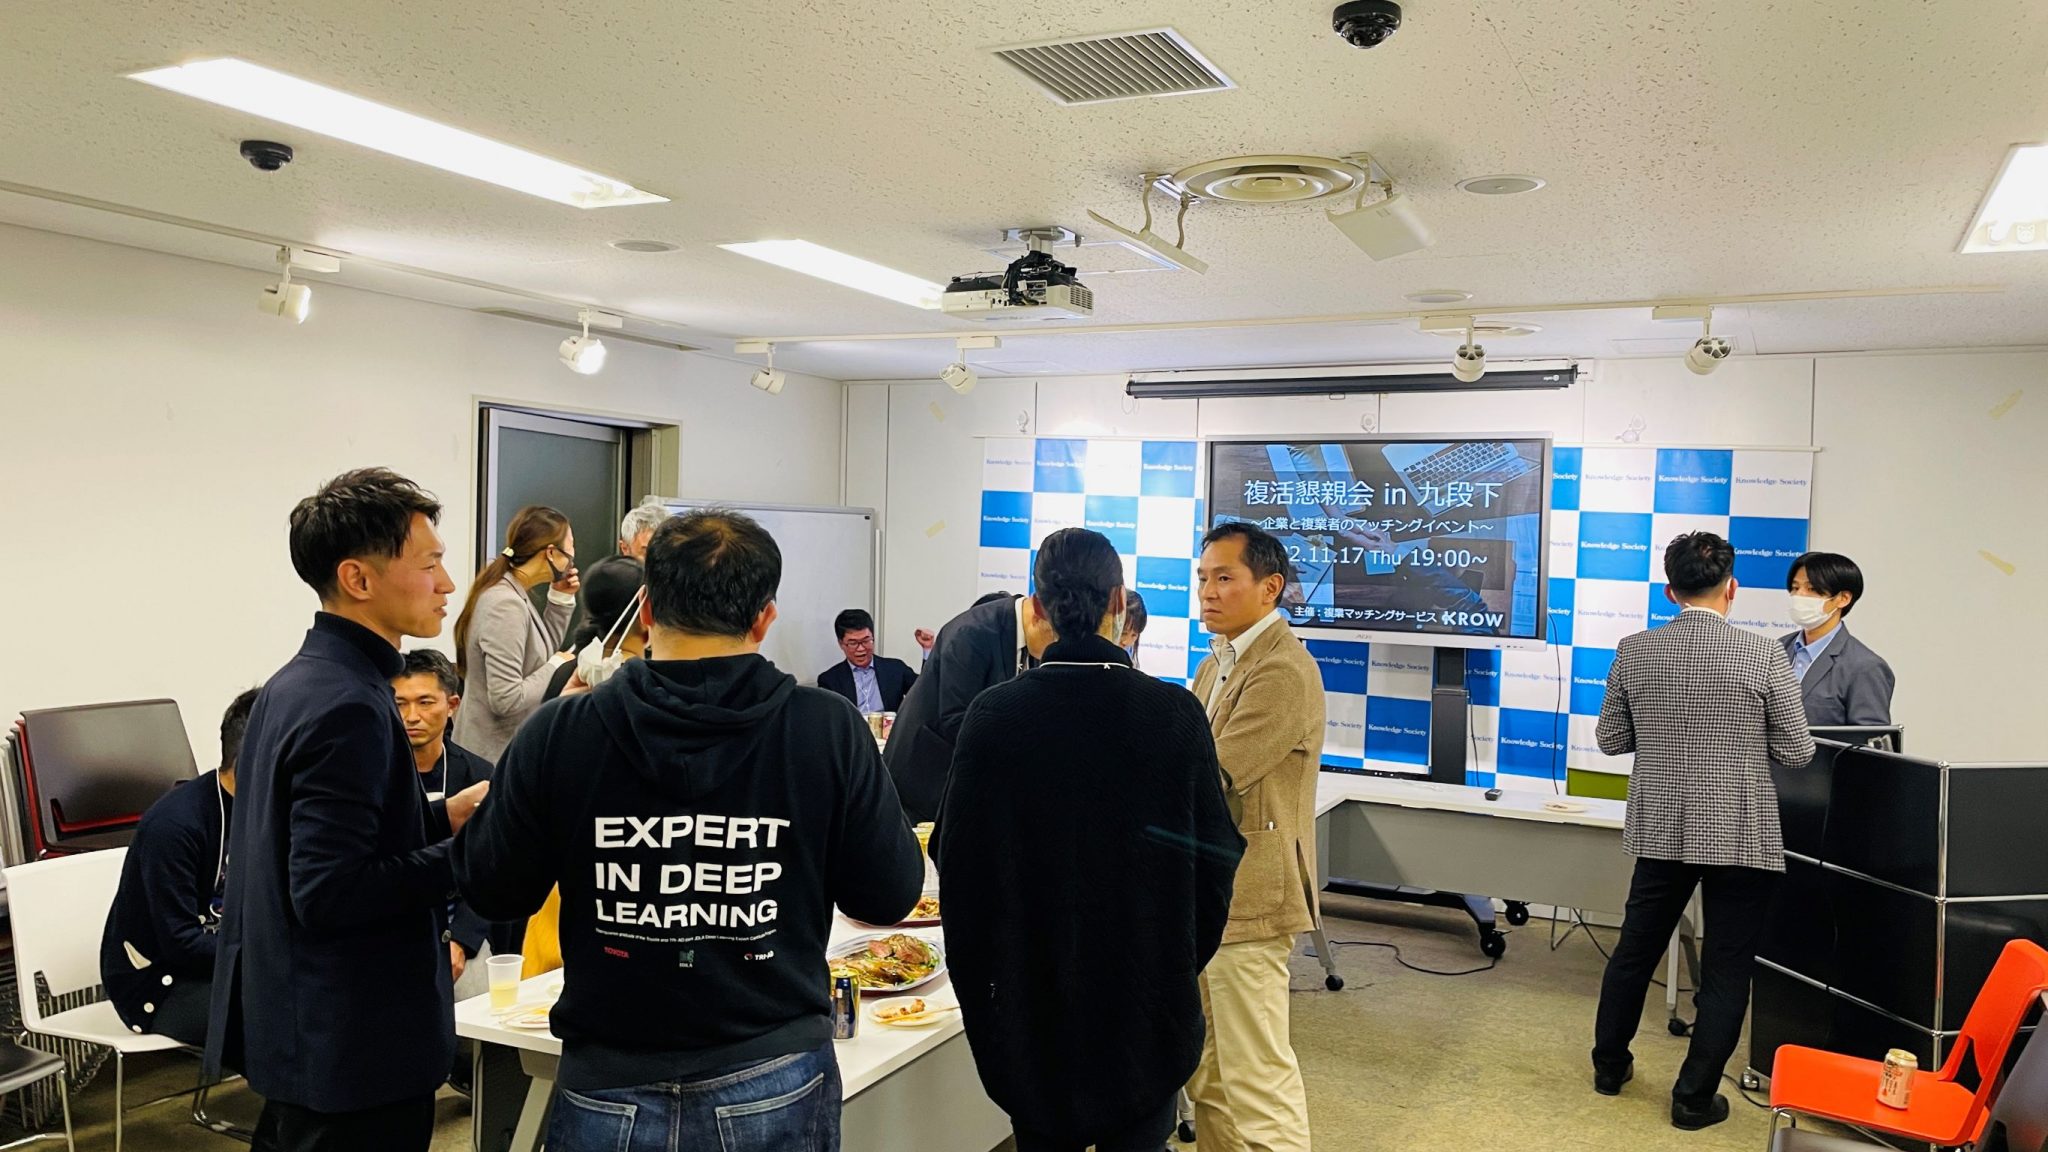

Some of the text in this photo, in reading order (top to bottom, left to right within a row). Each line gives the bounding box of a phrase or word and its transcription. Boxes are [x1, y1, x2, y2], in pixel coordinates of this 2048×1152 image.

[1143, 463, 1172, 471] Knowledge
[1174, 464, 1193, 472] Society
[1553, 472, 1578, 481] Society
[1585, 473, 1650, 483] Knowledge Society
[1659, 474, 1728, 485] Knowledge Society
[1735, 476, 1807, 487] Knowledge Society
[1244, 480, 1503, 508] 複活懇親会 in 九段下
[983, 514, 1030, 524] Knowledge Society
[1086, 519, 1136, 529] Knowledge Society
[1581, 540, 1620, 550] Knowledge
[1621, 542, 1648, 551] Society
[1284, 545, 1364, 564] 2.11.17
[1370, 549, 1402, 565] Thu
[1734, 546, 1773, 557] Knowledge
[1137, 581, 1188, 591] Knowledge Society
[1547, 606, 1571, 617] Society
[1577, 610, 1644, 620] Knowledge Society
[1442, 611, 1504, 628] KROW
[1651, 614, 1677, 623] Knowl
[1728, 618, 1797, 629] Knowledge Society
[1315, 657, 1365, 667] nowledge Society
[1371, 660, 1430, 672] Knowledge Society
[1474, 669, 1499, 678] Society
[1504, 671, 1539, 681] Knowledge
[1574, 676, 1606, 686] Knowledg
[1340, 721, 1362, 730] Society
[1368, 724, 1427, 737] Knowledge Society
[1501, 736, 1564, 750] Knowledge Society
[595, 814, 791, 849] EXPERT
[595, 861, 783, 895] IN DEEP
[595, 898, 778, 929] LEARNING
[604, 945, 630, 960] TOYOTA
